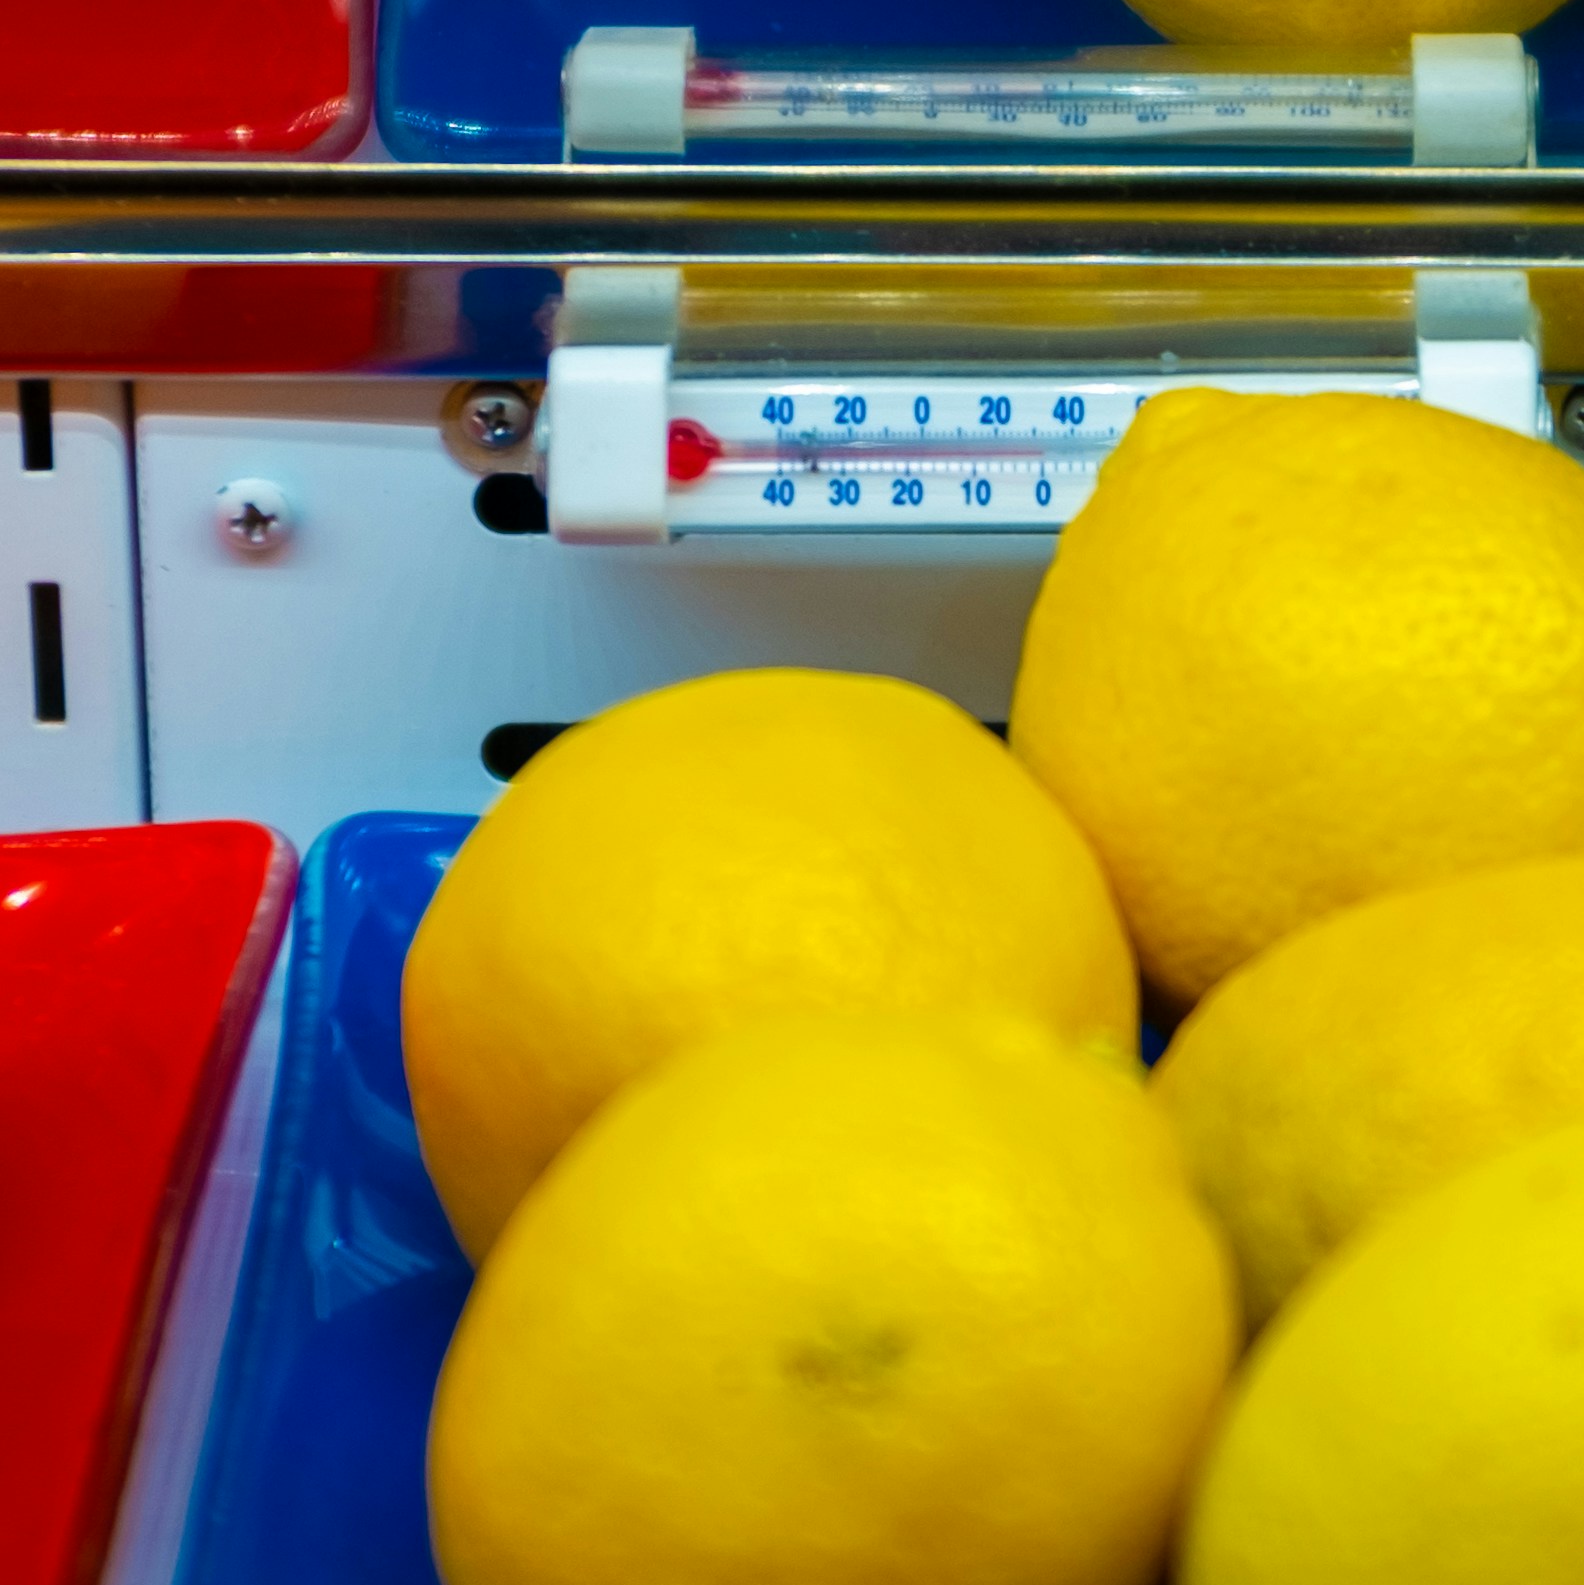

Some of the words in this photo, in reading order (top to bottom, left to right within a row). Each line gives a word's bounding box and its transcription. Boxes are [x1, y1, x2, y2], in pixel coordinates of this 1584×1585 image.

[762, 395, 795, 426] 40
[834, 395, 867, 426] 20
[913, 395, 931, 426] 0
[979, 395, 1012, 426] 20
[1052, 395, 1086, 426] 40
[762, 478, 796, 508] 40
[828, 478, 861, 507] 30
[891, 478, 924, 507] 20
[961, 478, 992, 507] 10
[1034, 478, 1052, 508] 0
